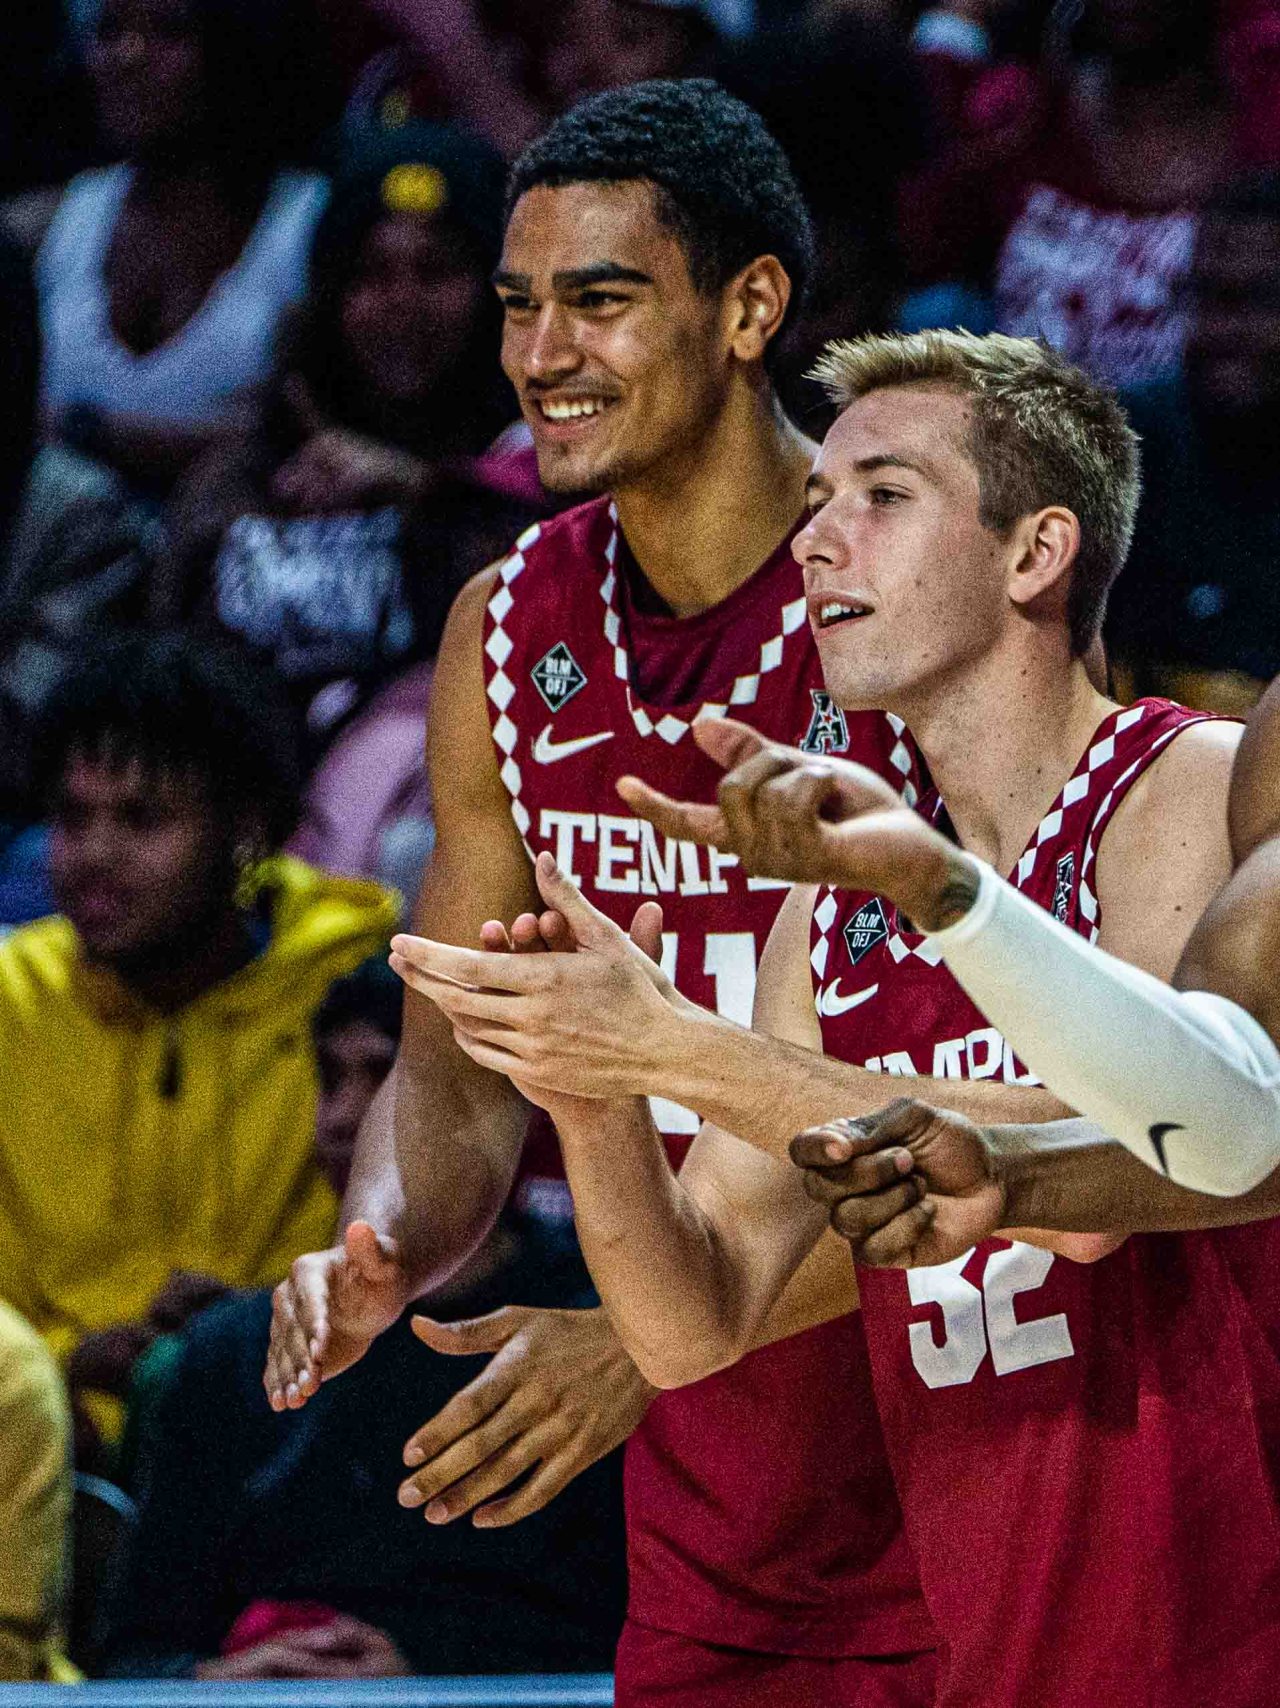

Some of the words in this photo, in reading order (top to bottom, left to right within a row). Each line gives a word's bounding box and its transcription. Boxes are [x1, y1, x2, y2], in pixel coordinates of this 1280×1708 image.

[855, 912, 881, 928] BLM
[851, 932, 871, 947] OFJ
[905, 1240, 1075, 1390] 32
